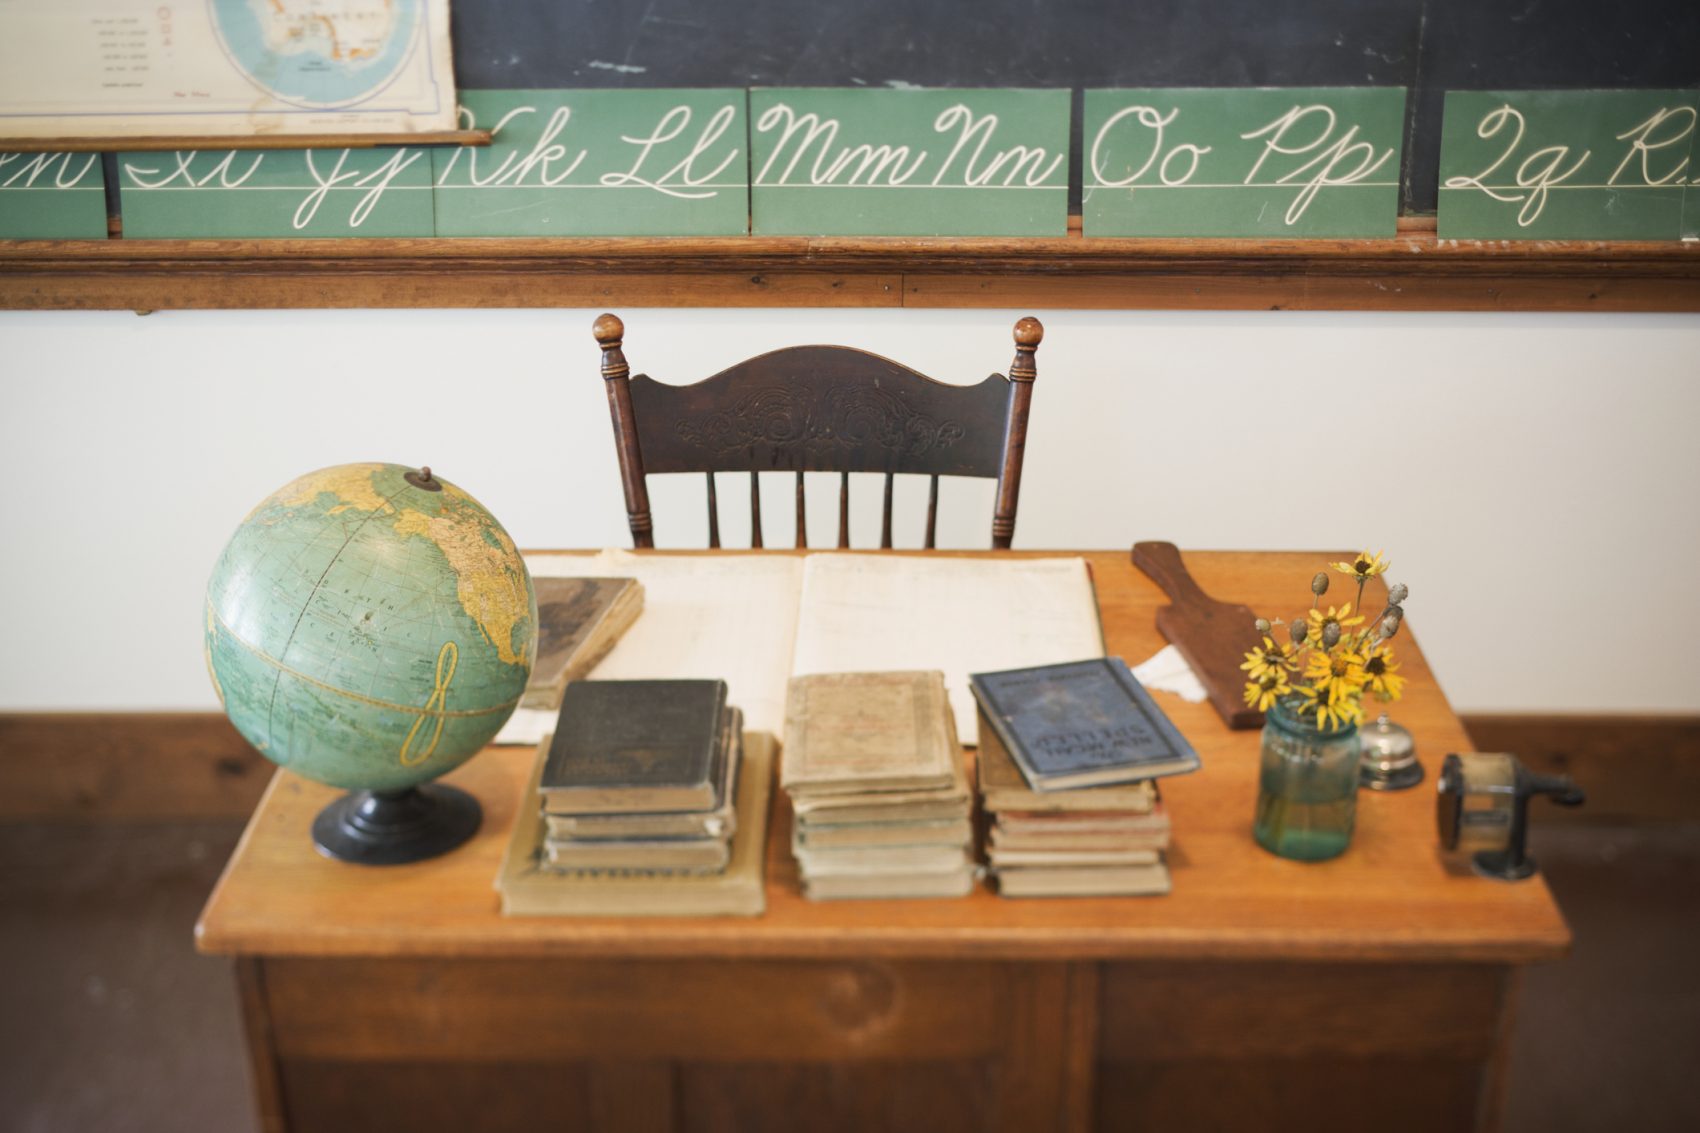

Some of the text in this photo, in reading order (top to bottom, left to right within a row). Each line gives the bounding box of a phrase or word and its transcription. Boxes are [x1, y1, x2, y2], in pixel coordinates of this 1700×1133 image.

[599, 105, 739, 199] Ll
[754, 103, 1064, 187] Mm Nn
[1090, 104, 1395, 225] Oo Pp
[1444, 104, 1592, 228] Qq
